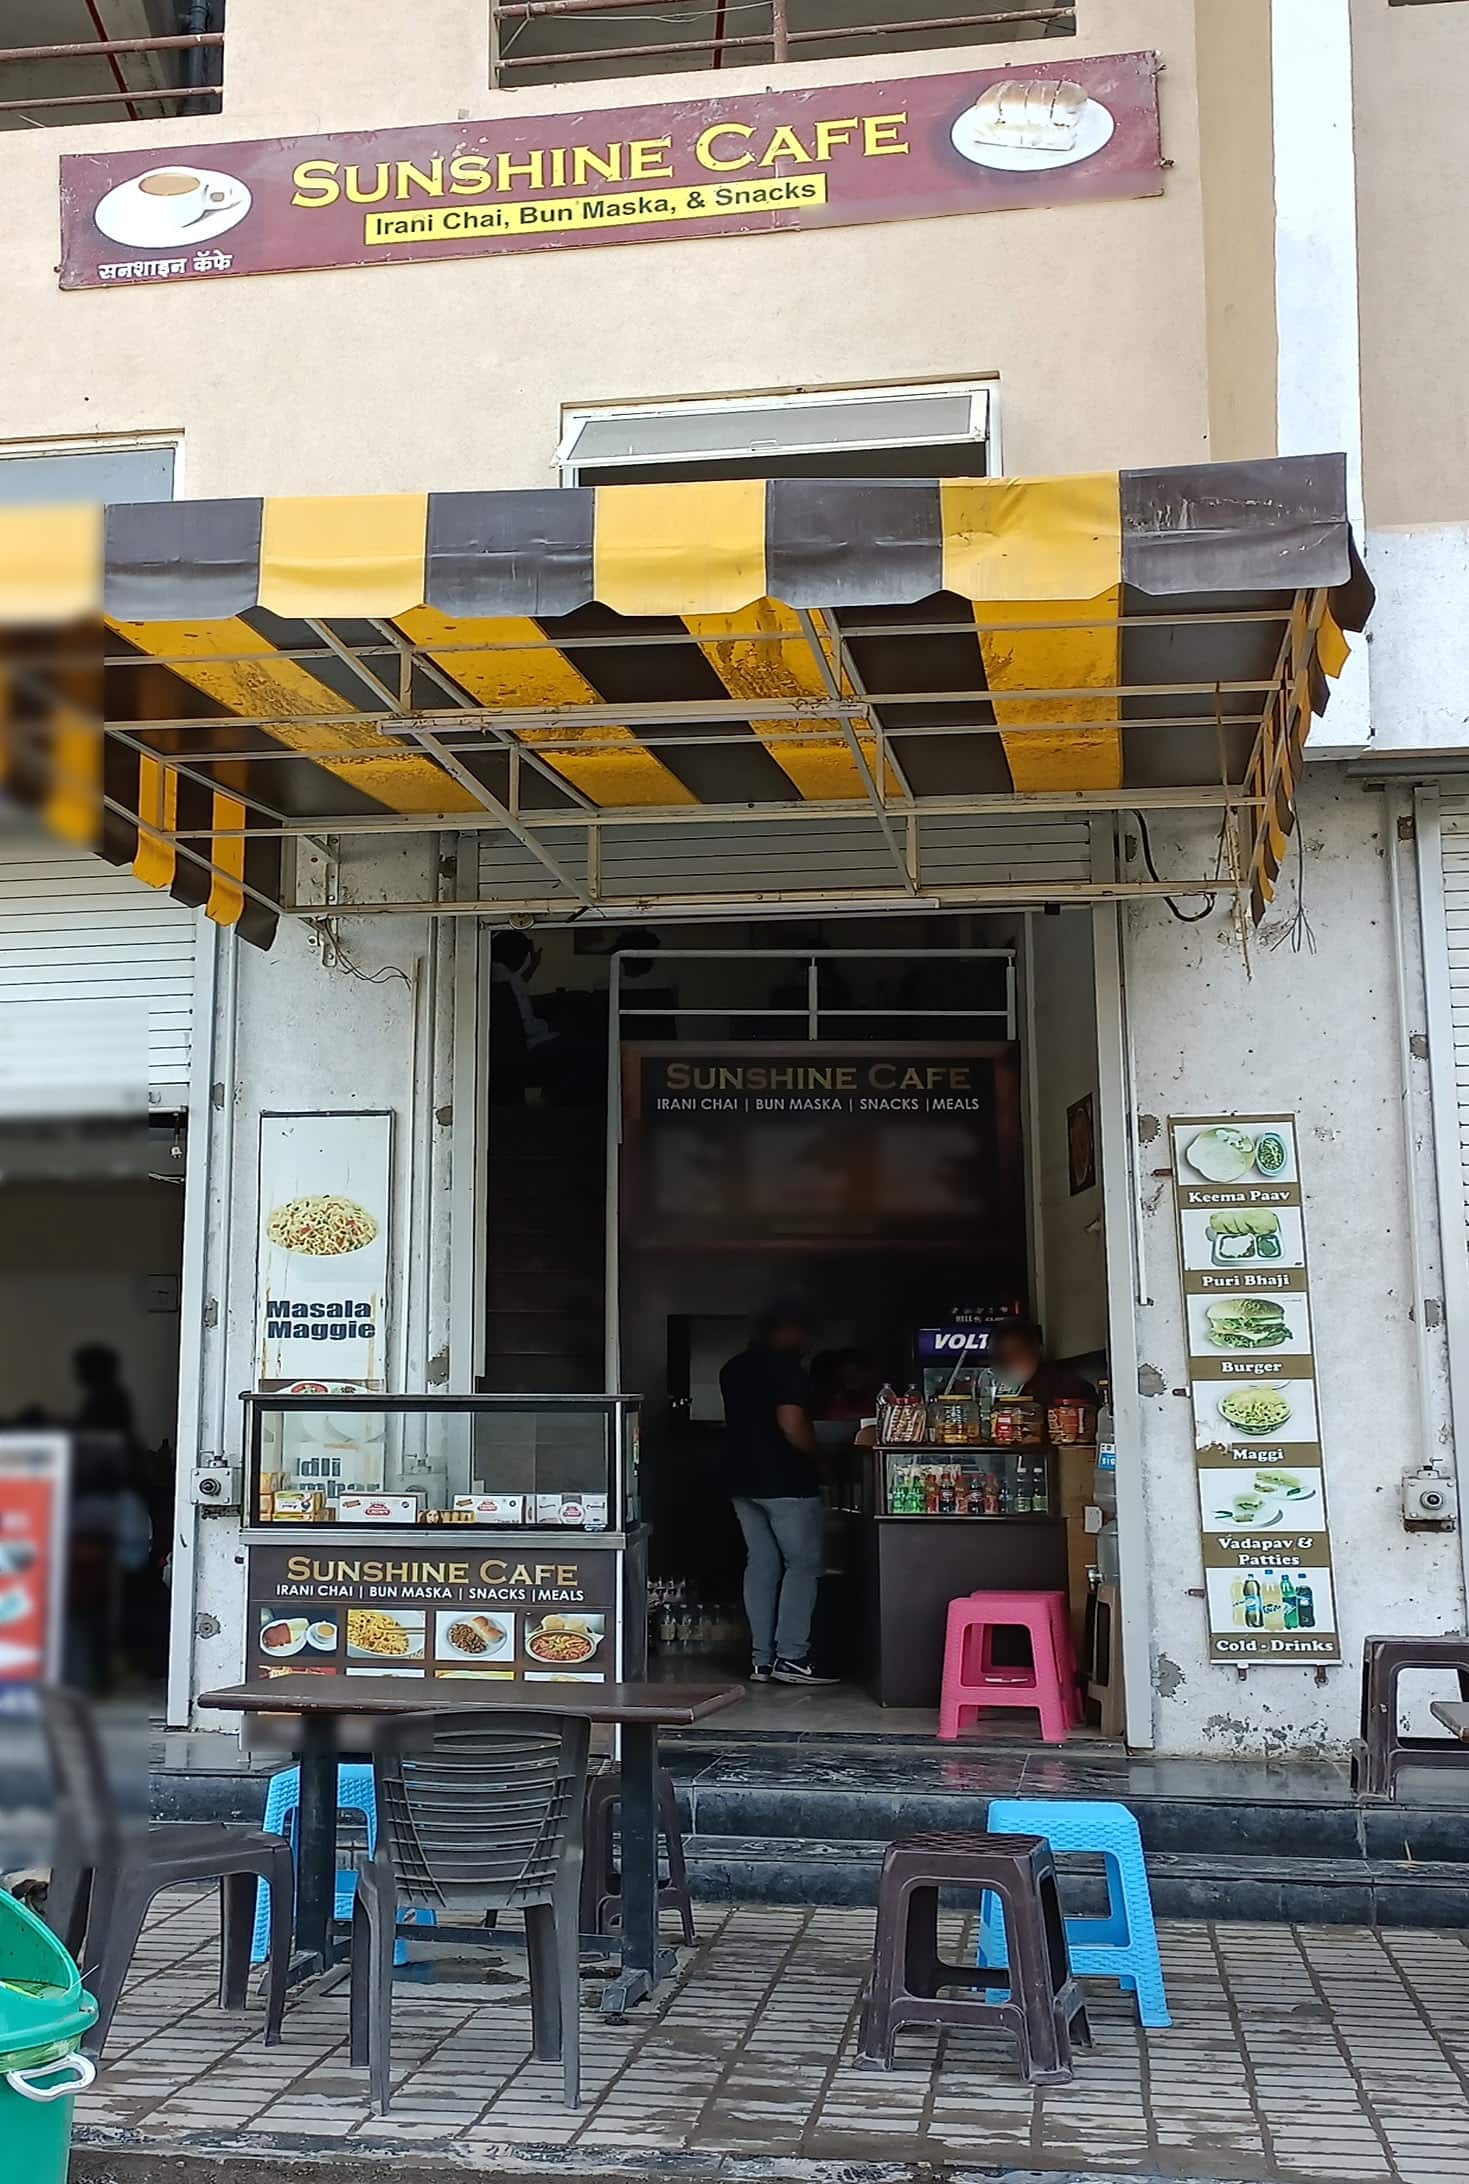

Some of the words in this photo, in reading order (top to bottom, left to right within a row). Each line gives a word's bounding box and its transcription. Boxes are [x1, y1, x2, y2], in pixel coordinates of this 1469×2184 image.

[291, 136, 673, 208] SUNSHINE
[695, 112, 909, 173] CAFE
[375, 213, 434, 236] Irani
[442, 209, 510, 232] Chai,
[520, 205, 573, 225] Bun
[582, 196, 676, 220] Maska,
[686, 190, 706, 209] &
[715, 181, 817, 206] Snacks
[98, 258, 187, 279] सनशाइन
[666, 1063, 857, 1090] SUNSHINE
[868, 1063, 971, 1090] CAFE
[657, 1098, 696, 1110] IRANI
[701, 1098, 738, 1110] CHAI
[756, 1098, 787, 1110] BUN
[789, 1098, 843, 1110] MASKA
[859, 1098, 919, 1110] SNACKS
[1189, 1191, 1246, 1203] Keema
[1250, 1190, 1290, 1201] Paav
[1202, 1276, 1240, 1287] Puri
[1244, 1273, 1290, 1287] Bhaji
[266, 1300, 372, 1318] Masala
[267, 1320, 376, 1340] Maggie
[1221, 1361, 1282, 1374] Burger
[1232, 1448, 1284, 1462] Maggi
[1218, 1537, 1293, 1551] Vadapav
[1297, 1537, 1313, 1549] &
[1238, 1555, 1300, 1566] Patties
[287, 1556, 469, 1585] SUNSHINE
[480, 1559, 578, 1587] CAFE
[276, 1584, 314, 1597] IRANI
[319, 1585, 353, 1597] CHAI
[370, 1586, 397, 1598] BUN
[402, 1587, 452, 1599] MASKA
[469, 1588, 526, 1600] SNACKS
[1216, 1640, 1257, 1652] Cold
[1270, 1639, 1333, 1652] Drinks
